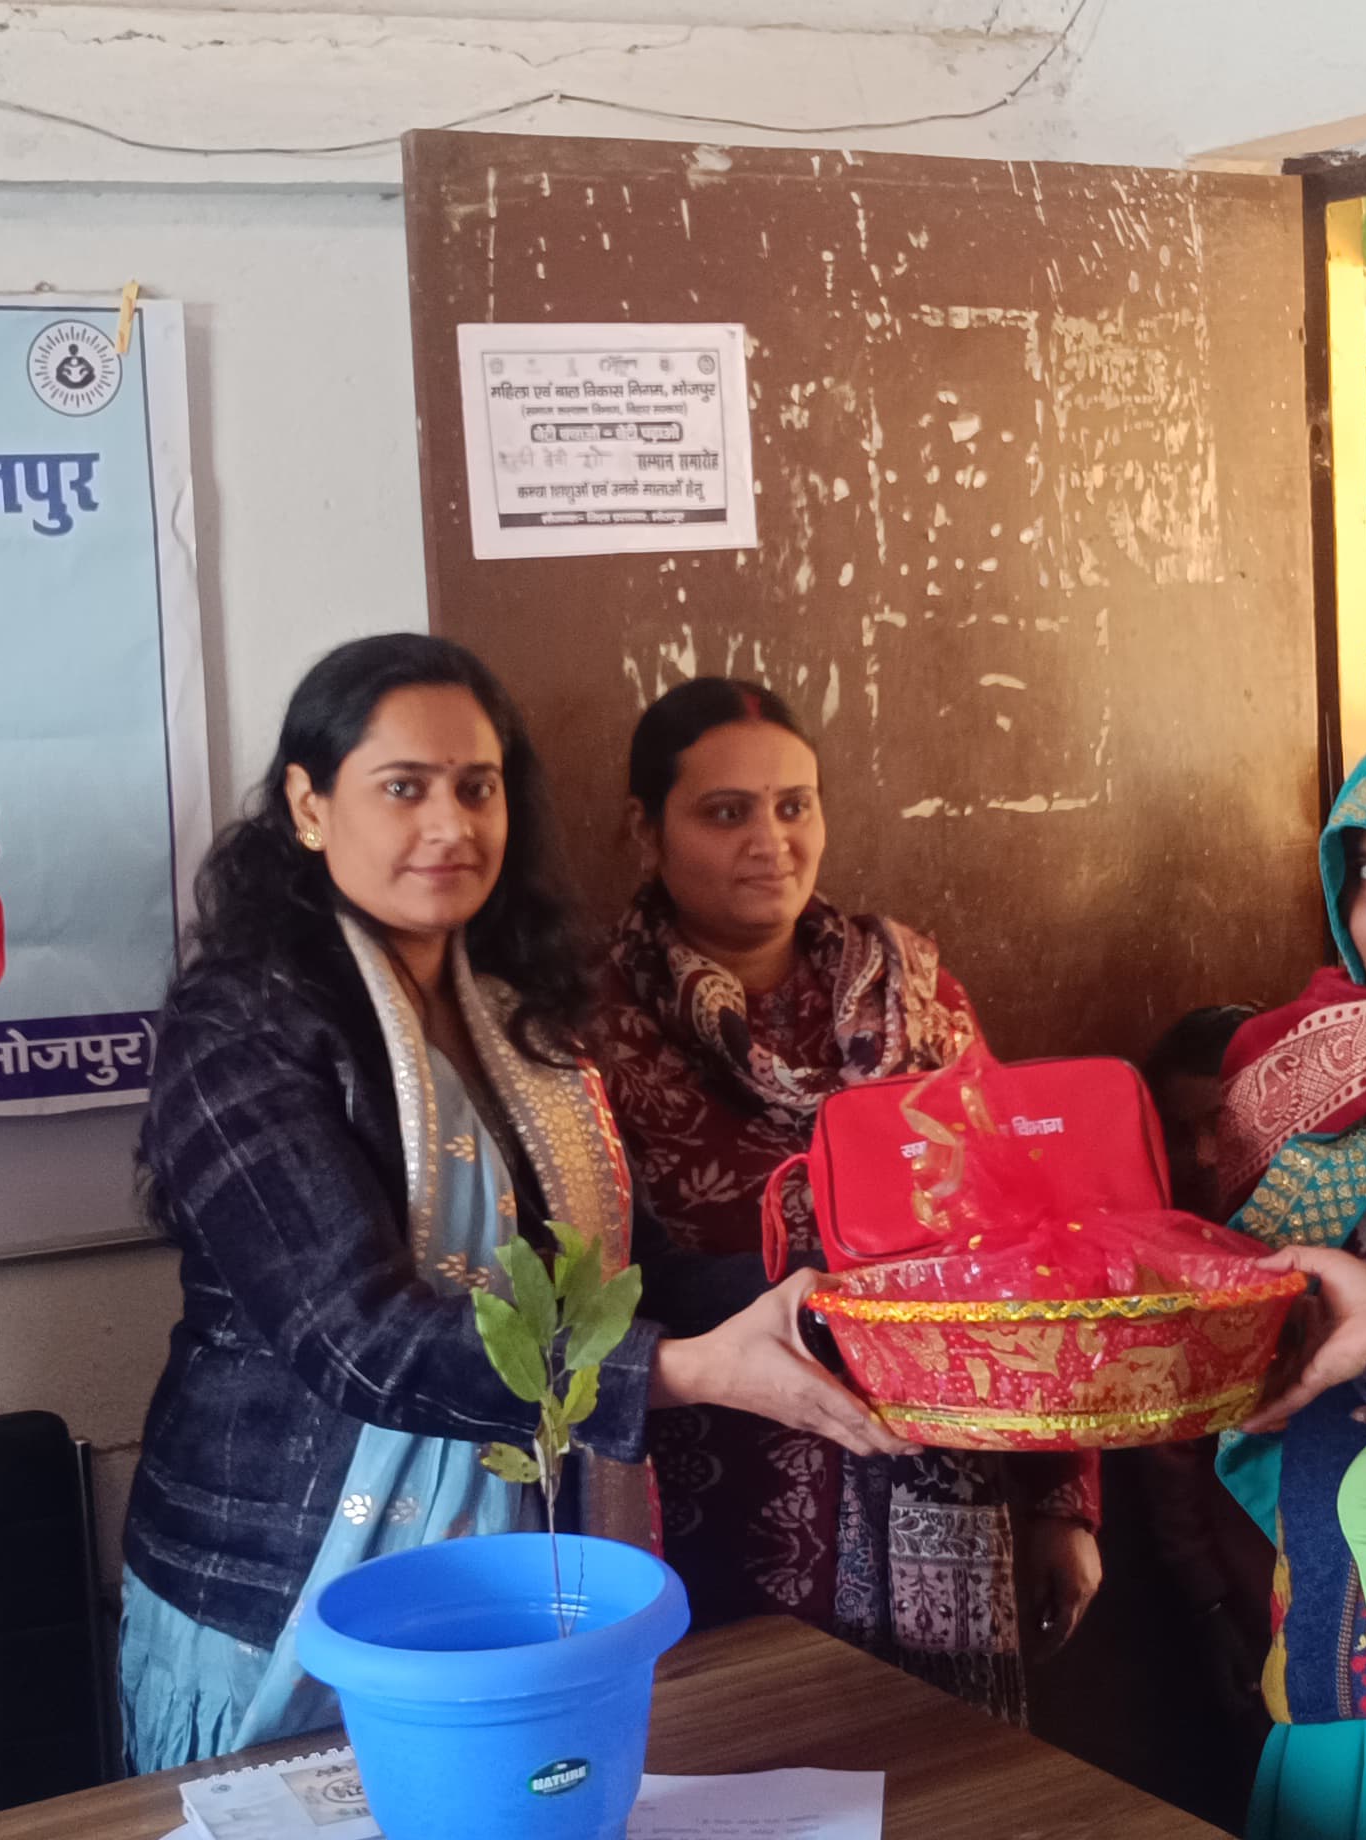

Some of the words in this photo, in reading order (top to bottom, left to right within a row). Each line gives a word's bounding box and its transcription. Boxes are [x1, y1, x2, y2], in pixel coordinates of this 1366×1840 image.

[490, 381, 530, 400] महिला
[582, 380, 624, 398] विकास
[671, 379, 716, 403] भोजपुर
[532, 1766, 587, 1791] NATURE
